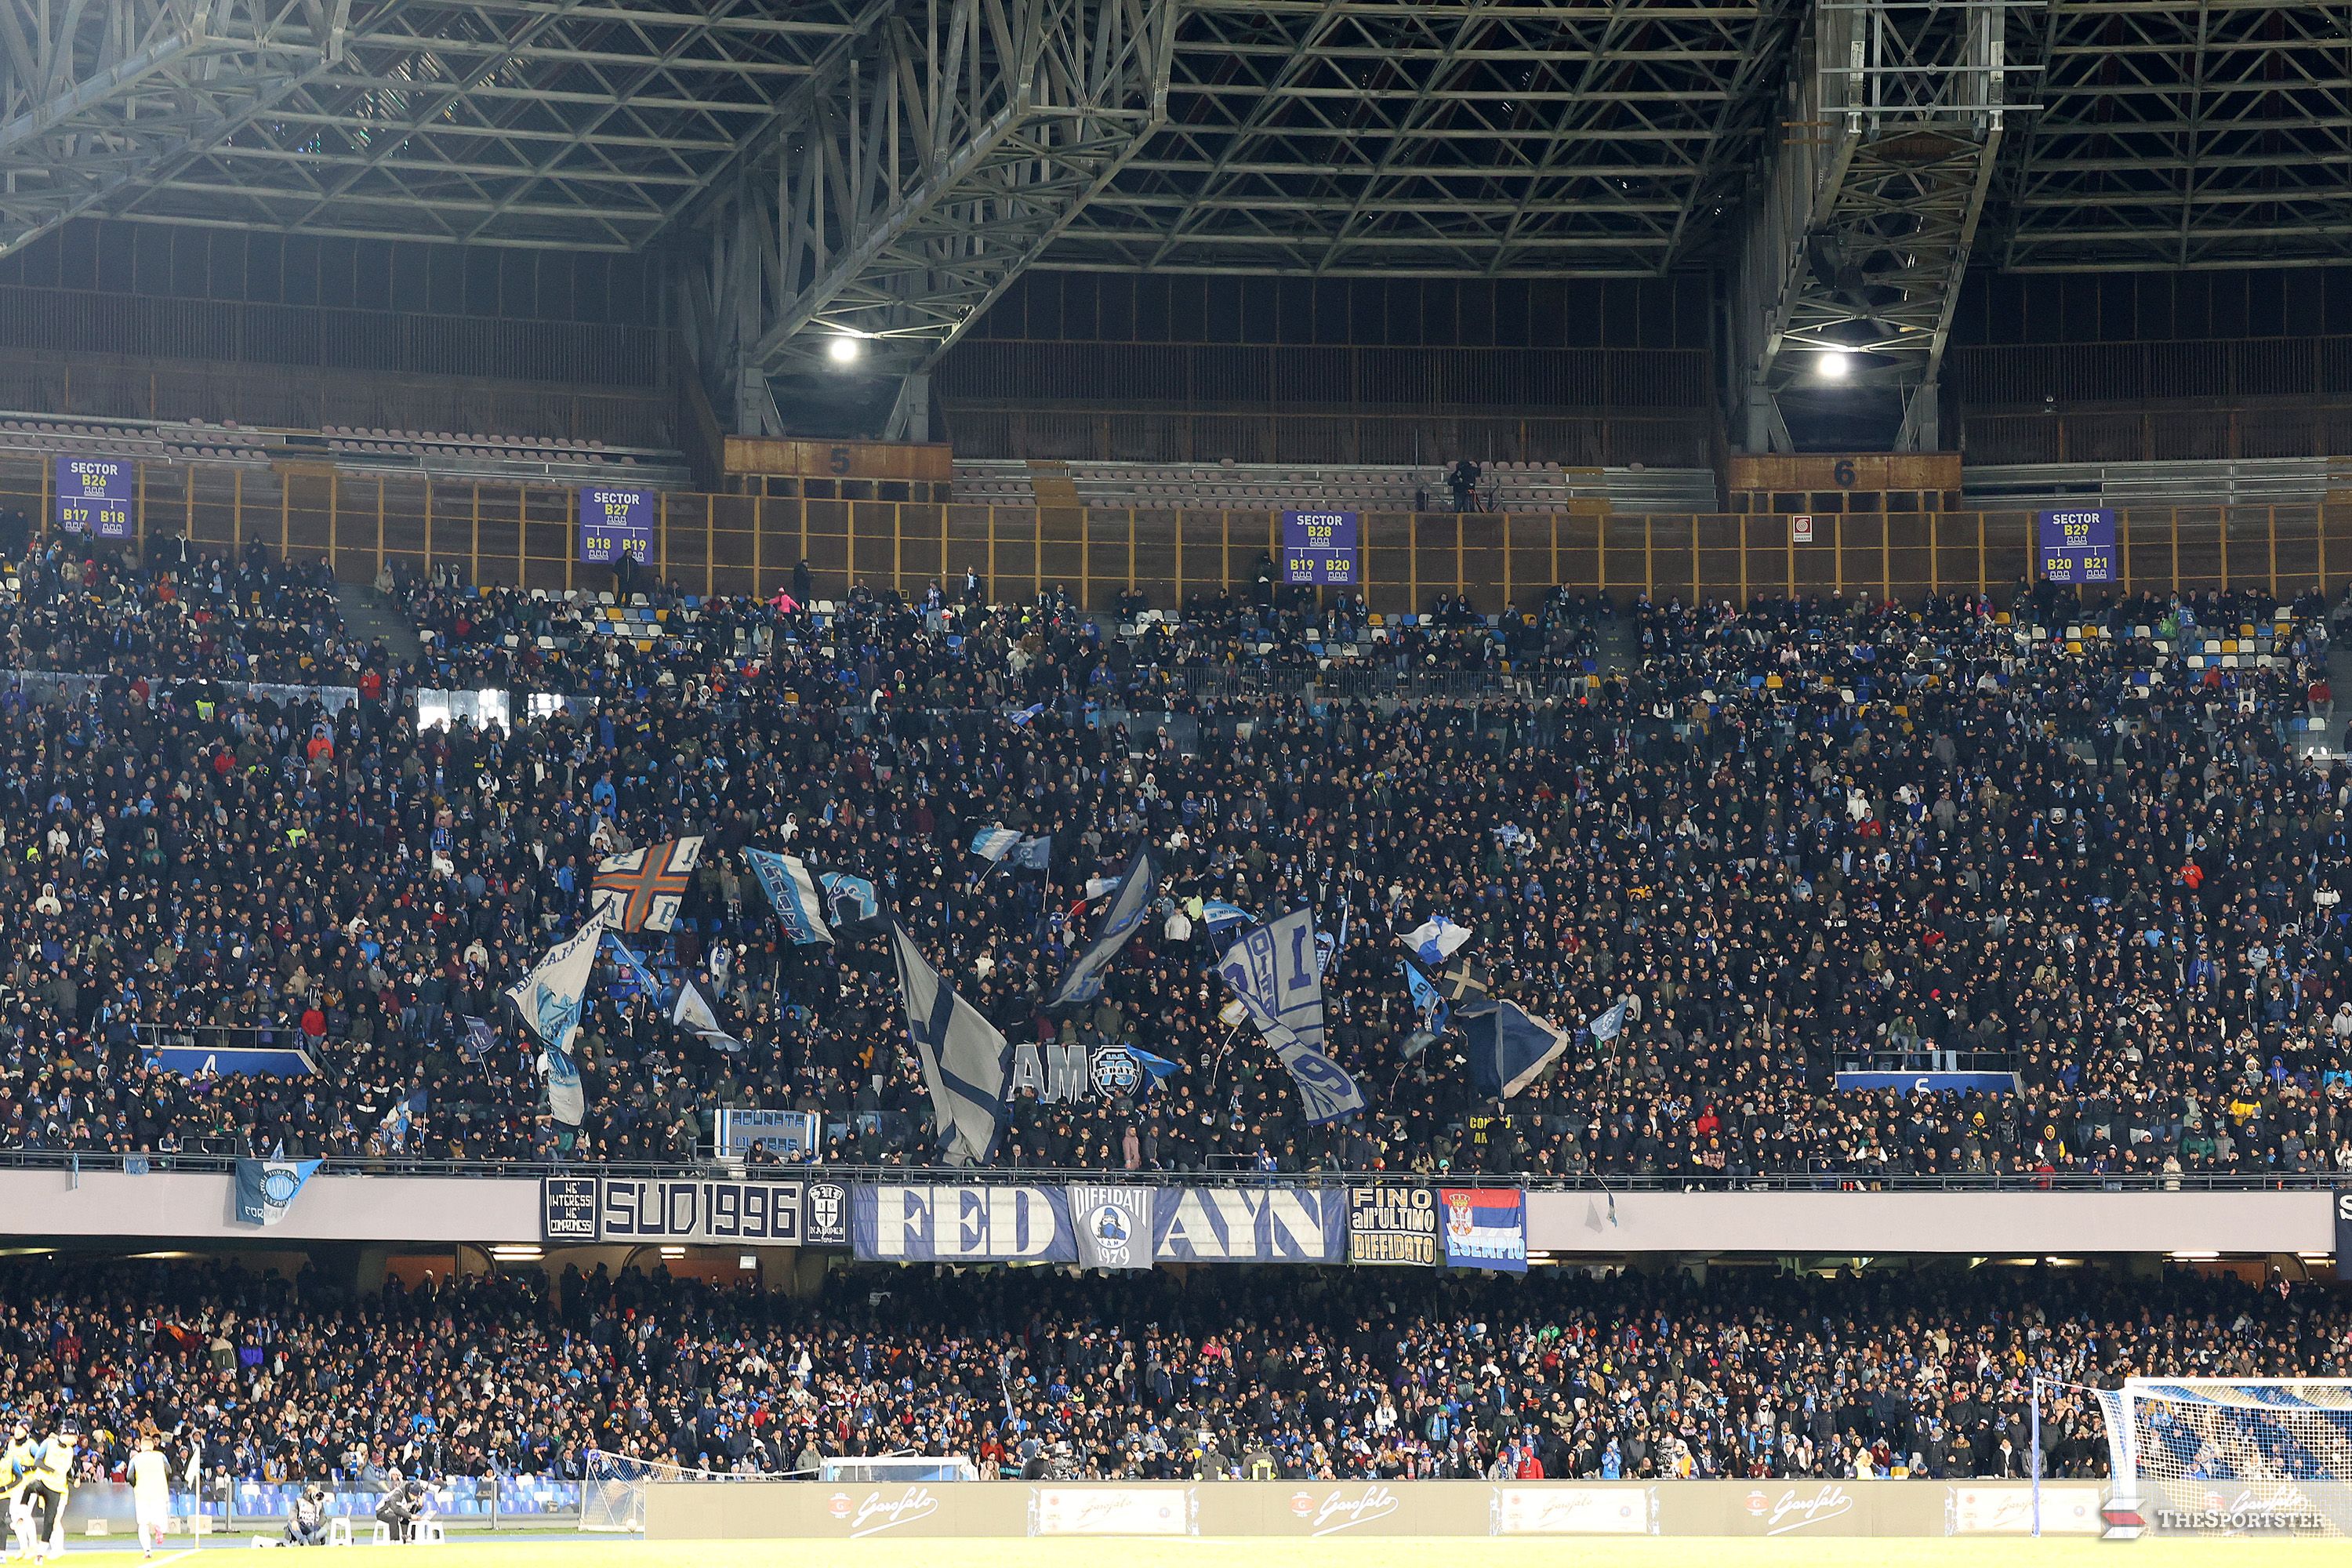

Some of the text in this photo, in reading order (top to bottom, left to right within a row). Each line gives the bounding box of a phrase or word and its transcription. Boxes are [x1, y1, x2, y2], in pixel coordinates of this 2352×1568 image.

[71, 462, 118, 475] SECTOR
[830, 448, 850, 474] 5
[82, 474, 107, 486] B26
[1835, 459, 1856, 488] 6
[593, 492, 640, 505] SECTOR
[64, 508, 125, 523] B17 B18
[604, 503, 629, 515] B27
[1297, 515, 1342, 525] SECTOR
[2053, 513, 2100, 524] SECTOR
[1308, 526, 1332, 537] B28
[2064, 524, 2089, 535] B29
[586, 537, 646, 551] B18 B19
[1290, 559, 1350, 571] B19 B20
[2047, 557, 2107, 570] B20 B21
[731, 1111, 805, 1129] ADUNATA
[550, 1194, 593, 1207] INTERESSI
[1352, 1188, 1432, 1209] FINO
[604, 1181, 798, 1240] SUD 1996
[1073, 1186, 1148, 1230] DIFFIDATI
[550, 1219, 593, 1232] COMPROMESSI
[877, 1186, 1055, 1255] FED
[1156, 1189, 1325, 1258] AYN
[1097, 1245, 1131, 1265] 1979
[1353, 1233, 1435, 1263] DIFFIDATO
[1446, 1236, 1525, 1260] ESEMPIO
[851, 1486, 938, 1537] Garofalo
[1312, 1485, 1399, 1536] Garofalo
[1767, 1484, 1853, 1535] Garofalo
